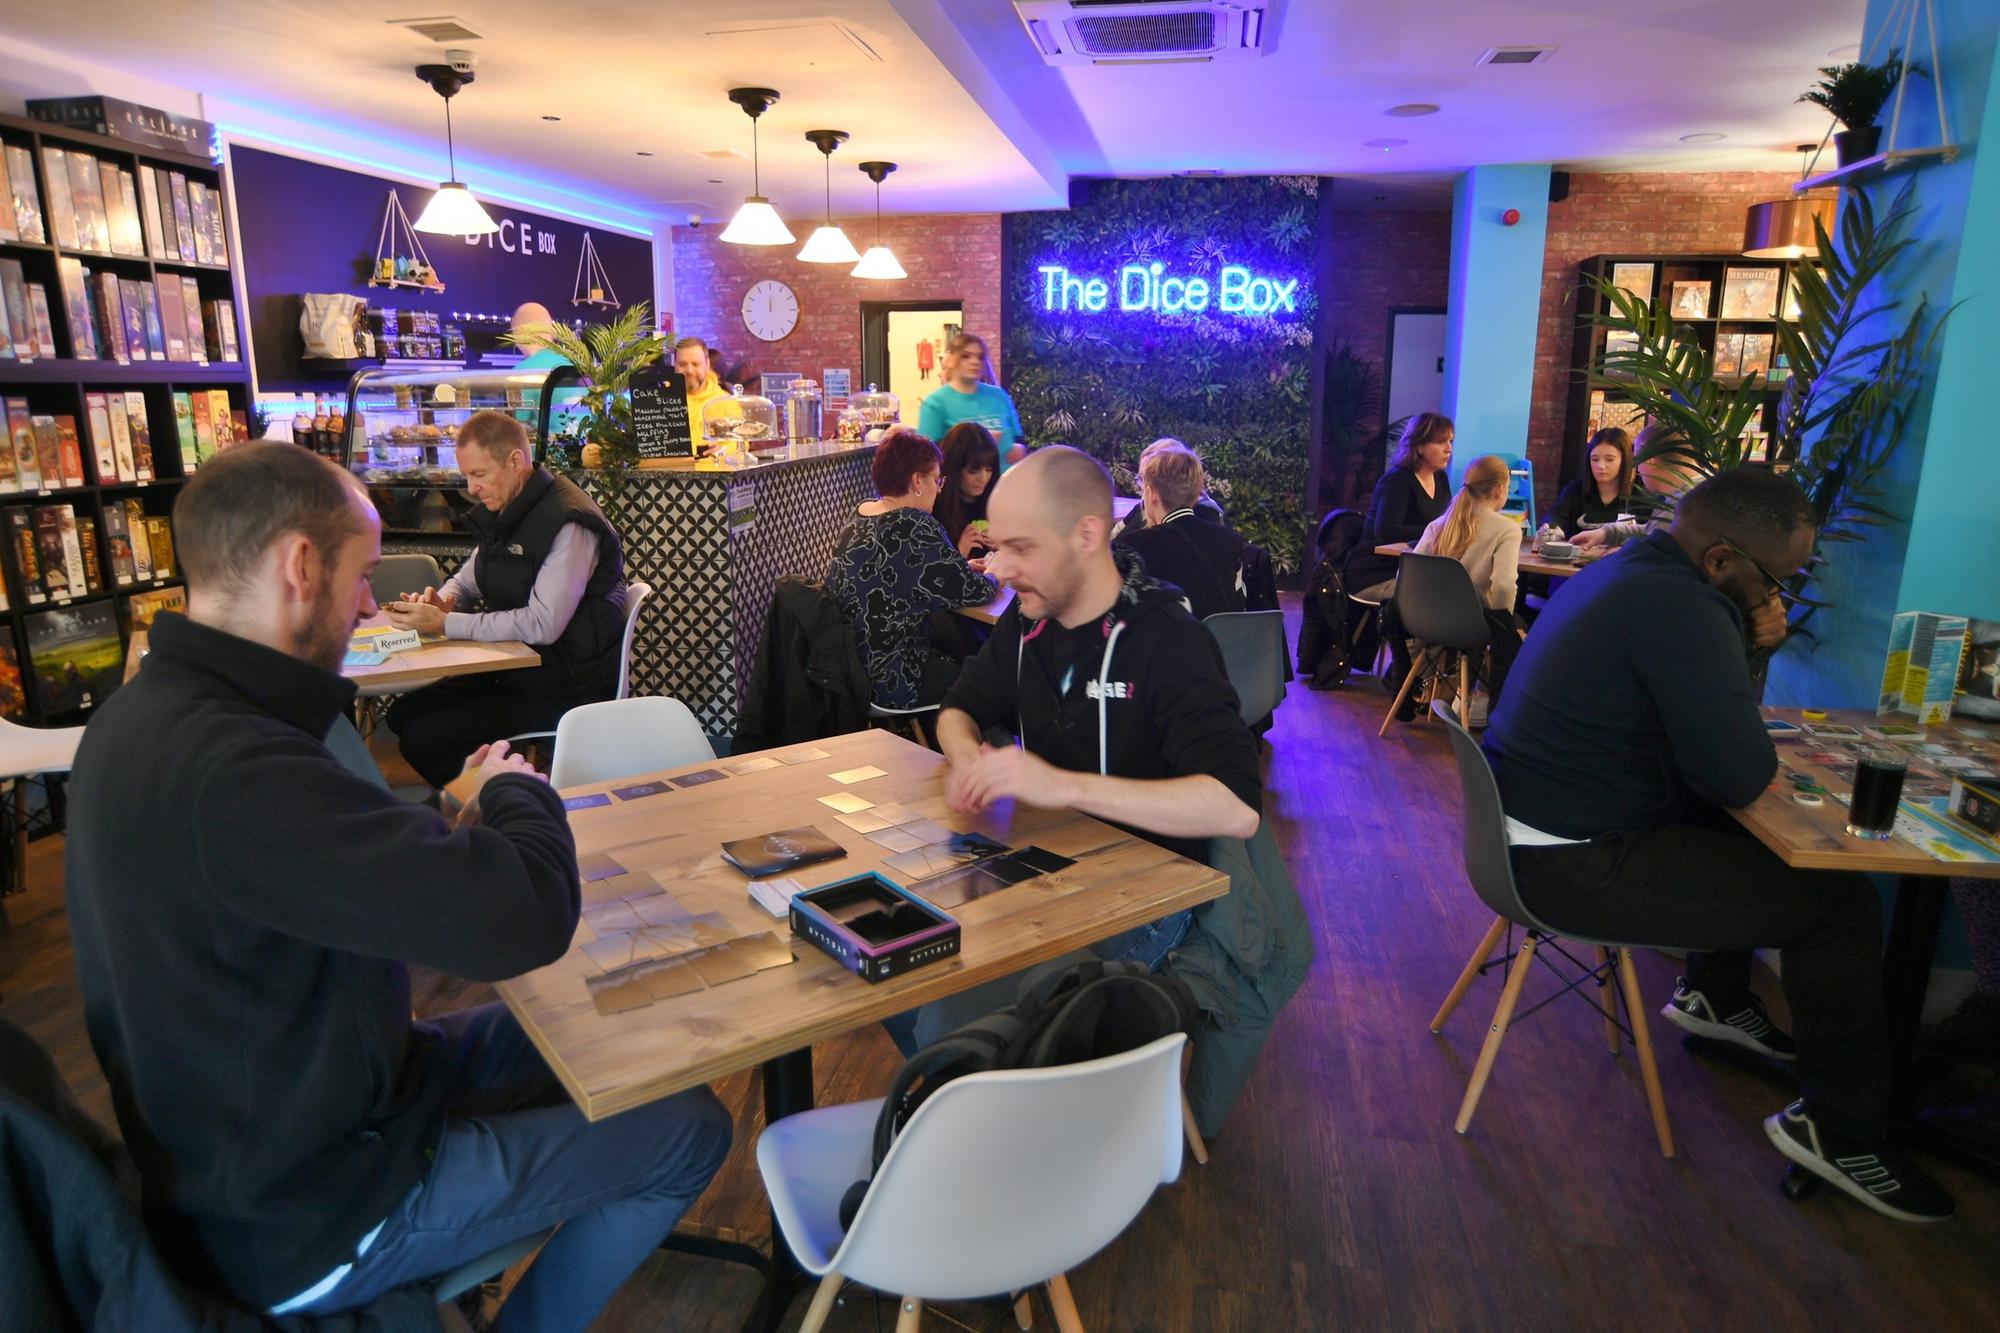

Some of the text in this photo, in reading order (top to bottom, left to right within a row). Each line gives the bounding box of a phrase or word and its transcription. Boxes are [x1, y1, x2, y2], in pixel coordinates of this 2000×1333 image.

[538, 231, 557, 255] BOX
[1038, 263, 1298, 313] The Dice Box
[380, 633, 416, 649] Reserved
